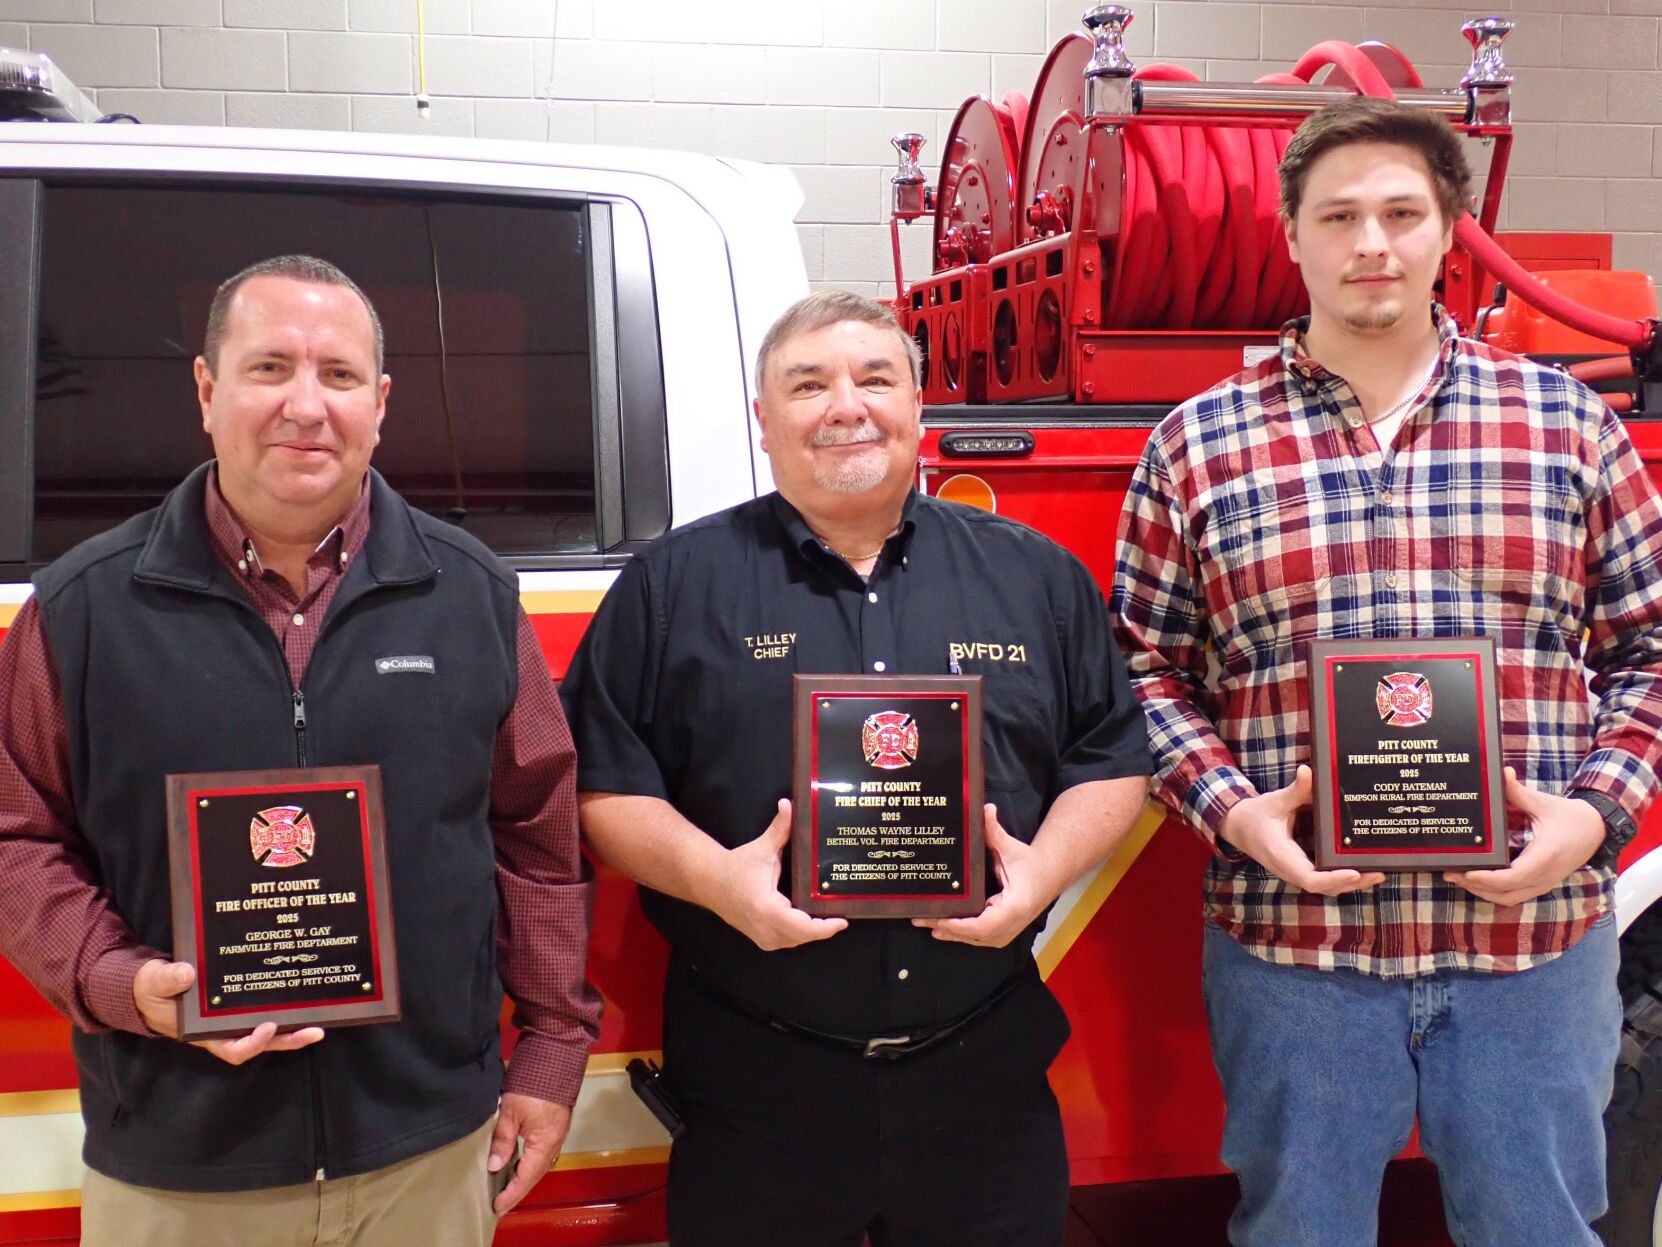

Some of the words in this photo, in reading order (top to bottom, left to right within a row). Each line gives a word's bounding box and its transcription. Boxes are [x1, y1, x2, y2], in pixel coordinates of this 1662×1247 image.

[745, 637, 754, 647] T.
[756, 633, 796, 646] LILLEY
[754, 646, 789, 659] CHIEF
[950, 643, 1003, 660] BVFD
[1008, 645, 1026, 662] 21
[390, 660, 433, 669] Columbia
[881, 733, 901, 747] FD
[1378, 740, 1400, 750] PITT
[1401, 739, 1438, 750] COUNTY
[1348, 754, 1409, 765] FIREFIGHTER
[1411, 754, 1424, 763] OF
[1425, 753, 1444, 763] THE
[1445, 753, 1470, 763] YEAR
[1400, 769, 1419, 777] 2025
[861, 782, 883, 792] PITT
[884, 782, 921, 792] COUNTY
[1374, 783, 1401, 791] CODY
[1402, 782, 1447, 791] BATEMAN
[835, 797, 857, 807] FIRE
[859, 797, 887, 807] CHIEF
[888, 797, 901, 806] OF
[902, 797, 921, 806] THE
[922, 797, 947, 806] YEAR
[1344, 793, 1378, 802] SIMPSON
[1380, 793, 1406, 801] RURAL
[1426, 792, 1478, 800] DEPARTMENT
[881, 812, 901, 821] 2025
[837, 827, 877, 835] THOMAS
[879, 827, 912, 835] WAYNE
[914, 827, 945, 835] LILLEY
[1352, 827, 1370, 835] THE
[1371, 827, 1408, 835] CITIZENS
[1441, 826, 1474, 834] COUNTY
[833, 864, 850, 872] FOR
[919, 872, 952, 880] COUNTY
[251, 882, 276, 894] PITT
[277, 879, 320, 892] COUNTY
[216, 901, 241, 912] FIRE
[242, 897, 288, 910] OFFICER
[289, 896, 304, 906] OF
[305, 894, 327, 906] THE
[328, 892, 356, 904] YEAR
[276, 913, 299, 923] 2025
[245, 930, 292, 942] GEORGE
[294, 928, 307, 938] W.
[309, 927, 332, 936] GAY
[219, 943, 272, 955] FARMVILLE
[273, 941, 295, 951] FIRE
[223, 975, 244, 983] FOR
[245, 969, 300, 981] DEDICATED
[301, 966, 341, 976] SERVICE
[342, 964, 356, 972] TO
[221, 984, 242, 993] THE
[243, 980, 287, 991] CITIZENS
[287, 979, 301, 988] OF
[302, 977, 323, 986] PITT
[323, 974, 361, 984] COUNTY
